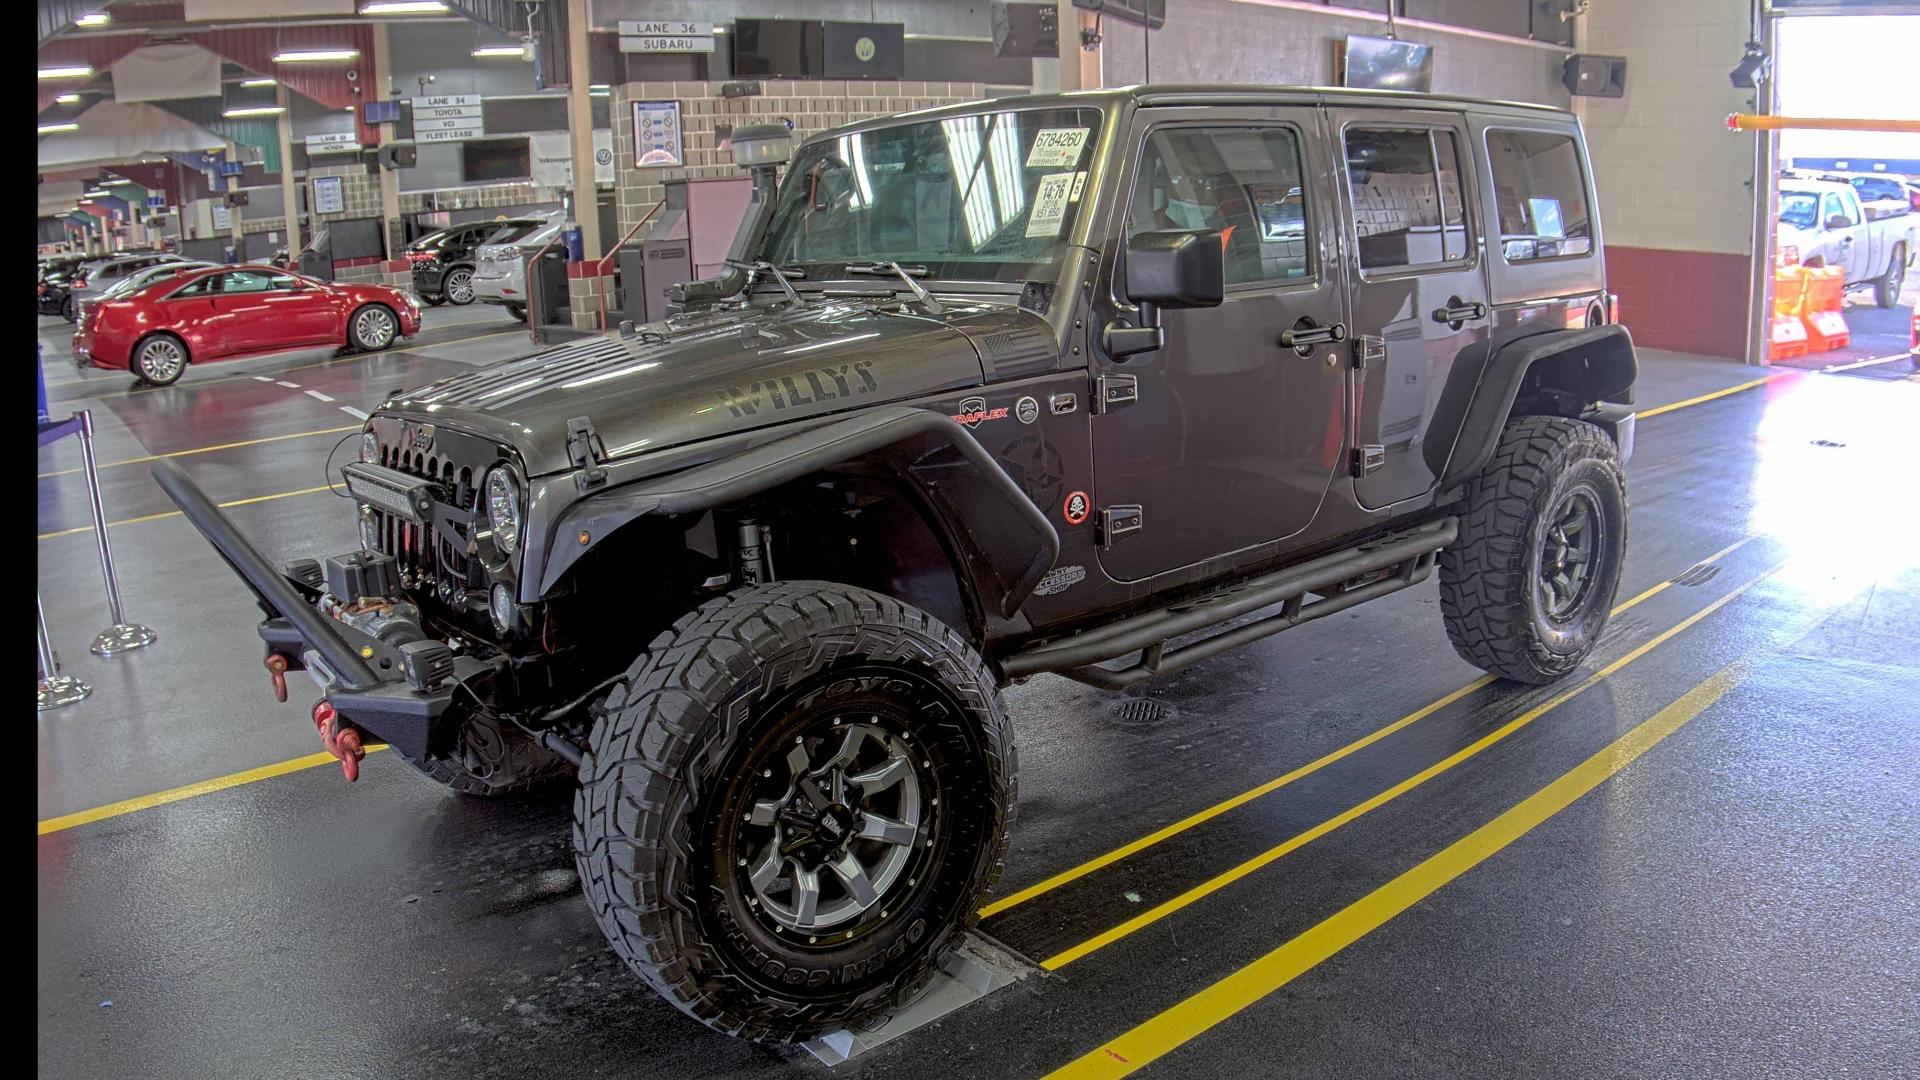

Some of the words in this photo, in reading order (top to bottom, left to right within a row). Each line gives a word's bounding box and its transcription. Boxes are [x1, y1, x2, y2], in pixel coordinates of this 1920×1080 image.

[636, 23, 669, 33] LANE
[681, 23, 696, 33] 36
[644, 39, 693, 49] SUBARU
[428, 97, 449, 105] LANE
[434, 108, 462, 117] TOYOTA
[450, 130, 472, 138] LEASE
[1036, 132, 1082, 147] 6784260
[715, 360, 878, 417] WILLYS
[1050, 582, 1069, 594] SHOP
[796, 676, 913, 711] TOYO
[840, 917, 927, 985] OPEN
